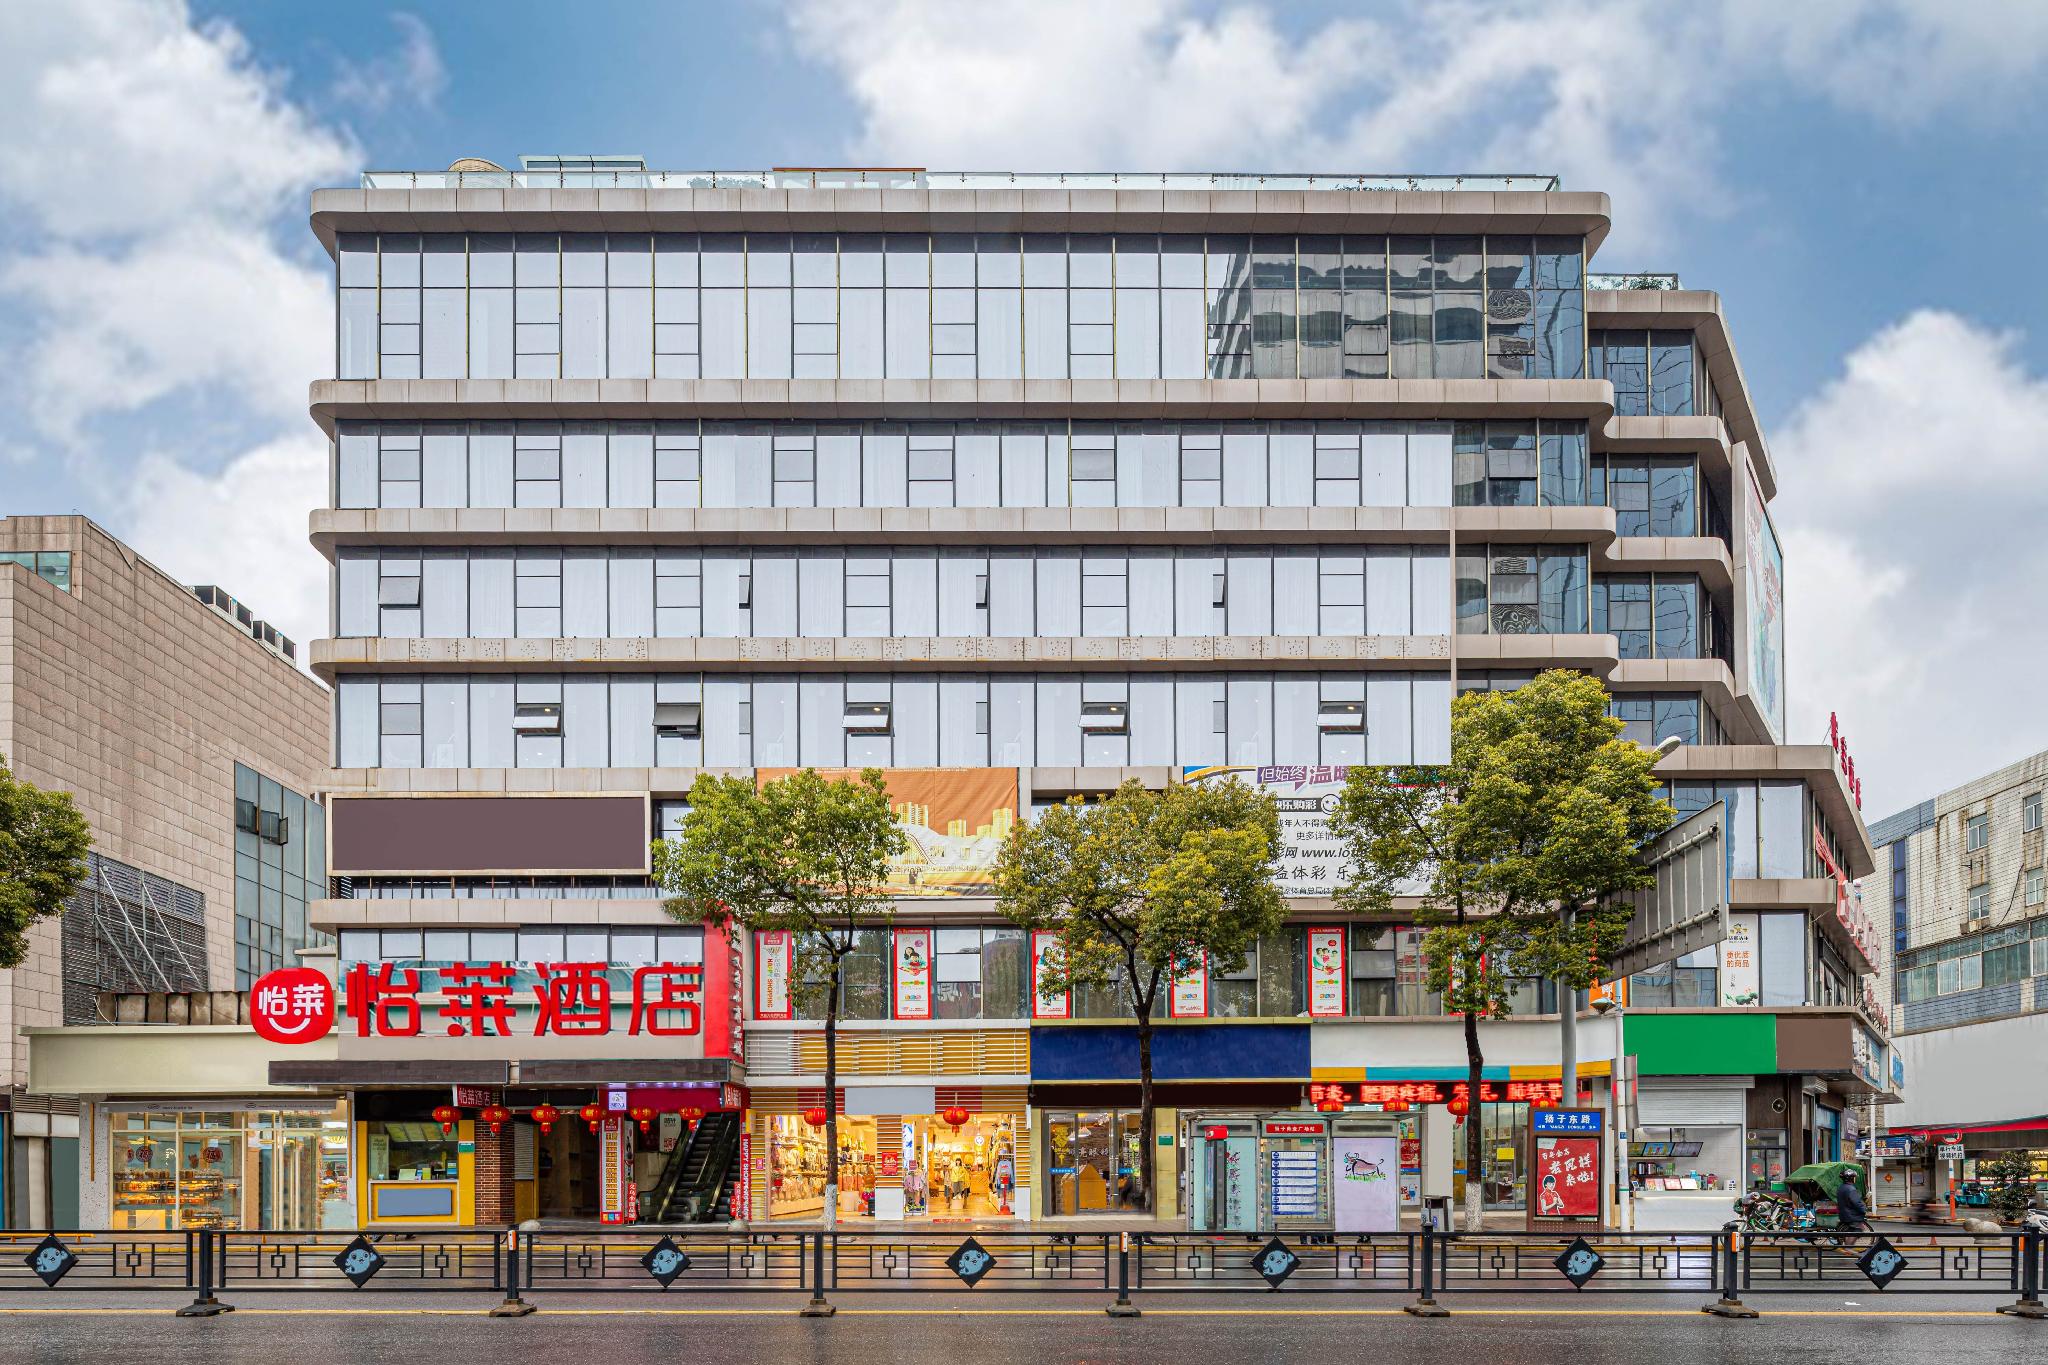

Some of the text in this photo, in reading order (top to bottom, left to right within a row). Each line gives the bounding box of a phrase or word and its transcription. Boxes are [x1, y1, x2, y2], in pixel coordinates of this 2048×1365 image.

[1260, 766, 1305, 781] 但始终
[258, 983, 325, 1016] 怡莱
[346, 961, 701, 1037] 怡莱酒店
[1544, 1114, 1591, 1124] 扬子东路
